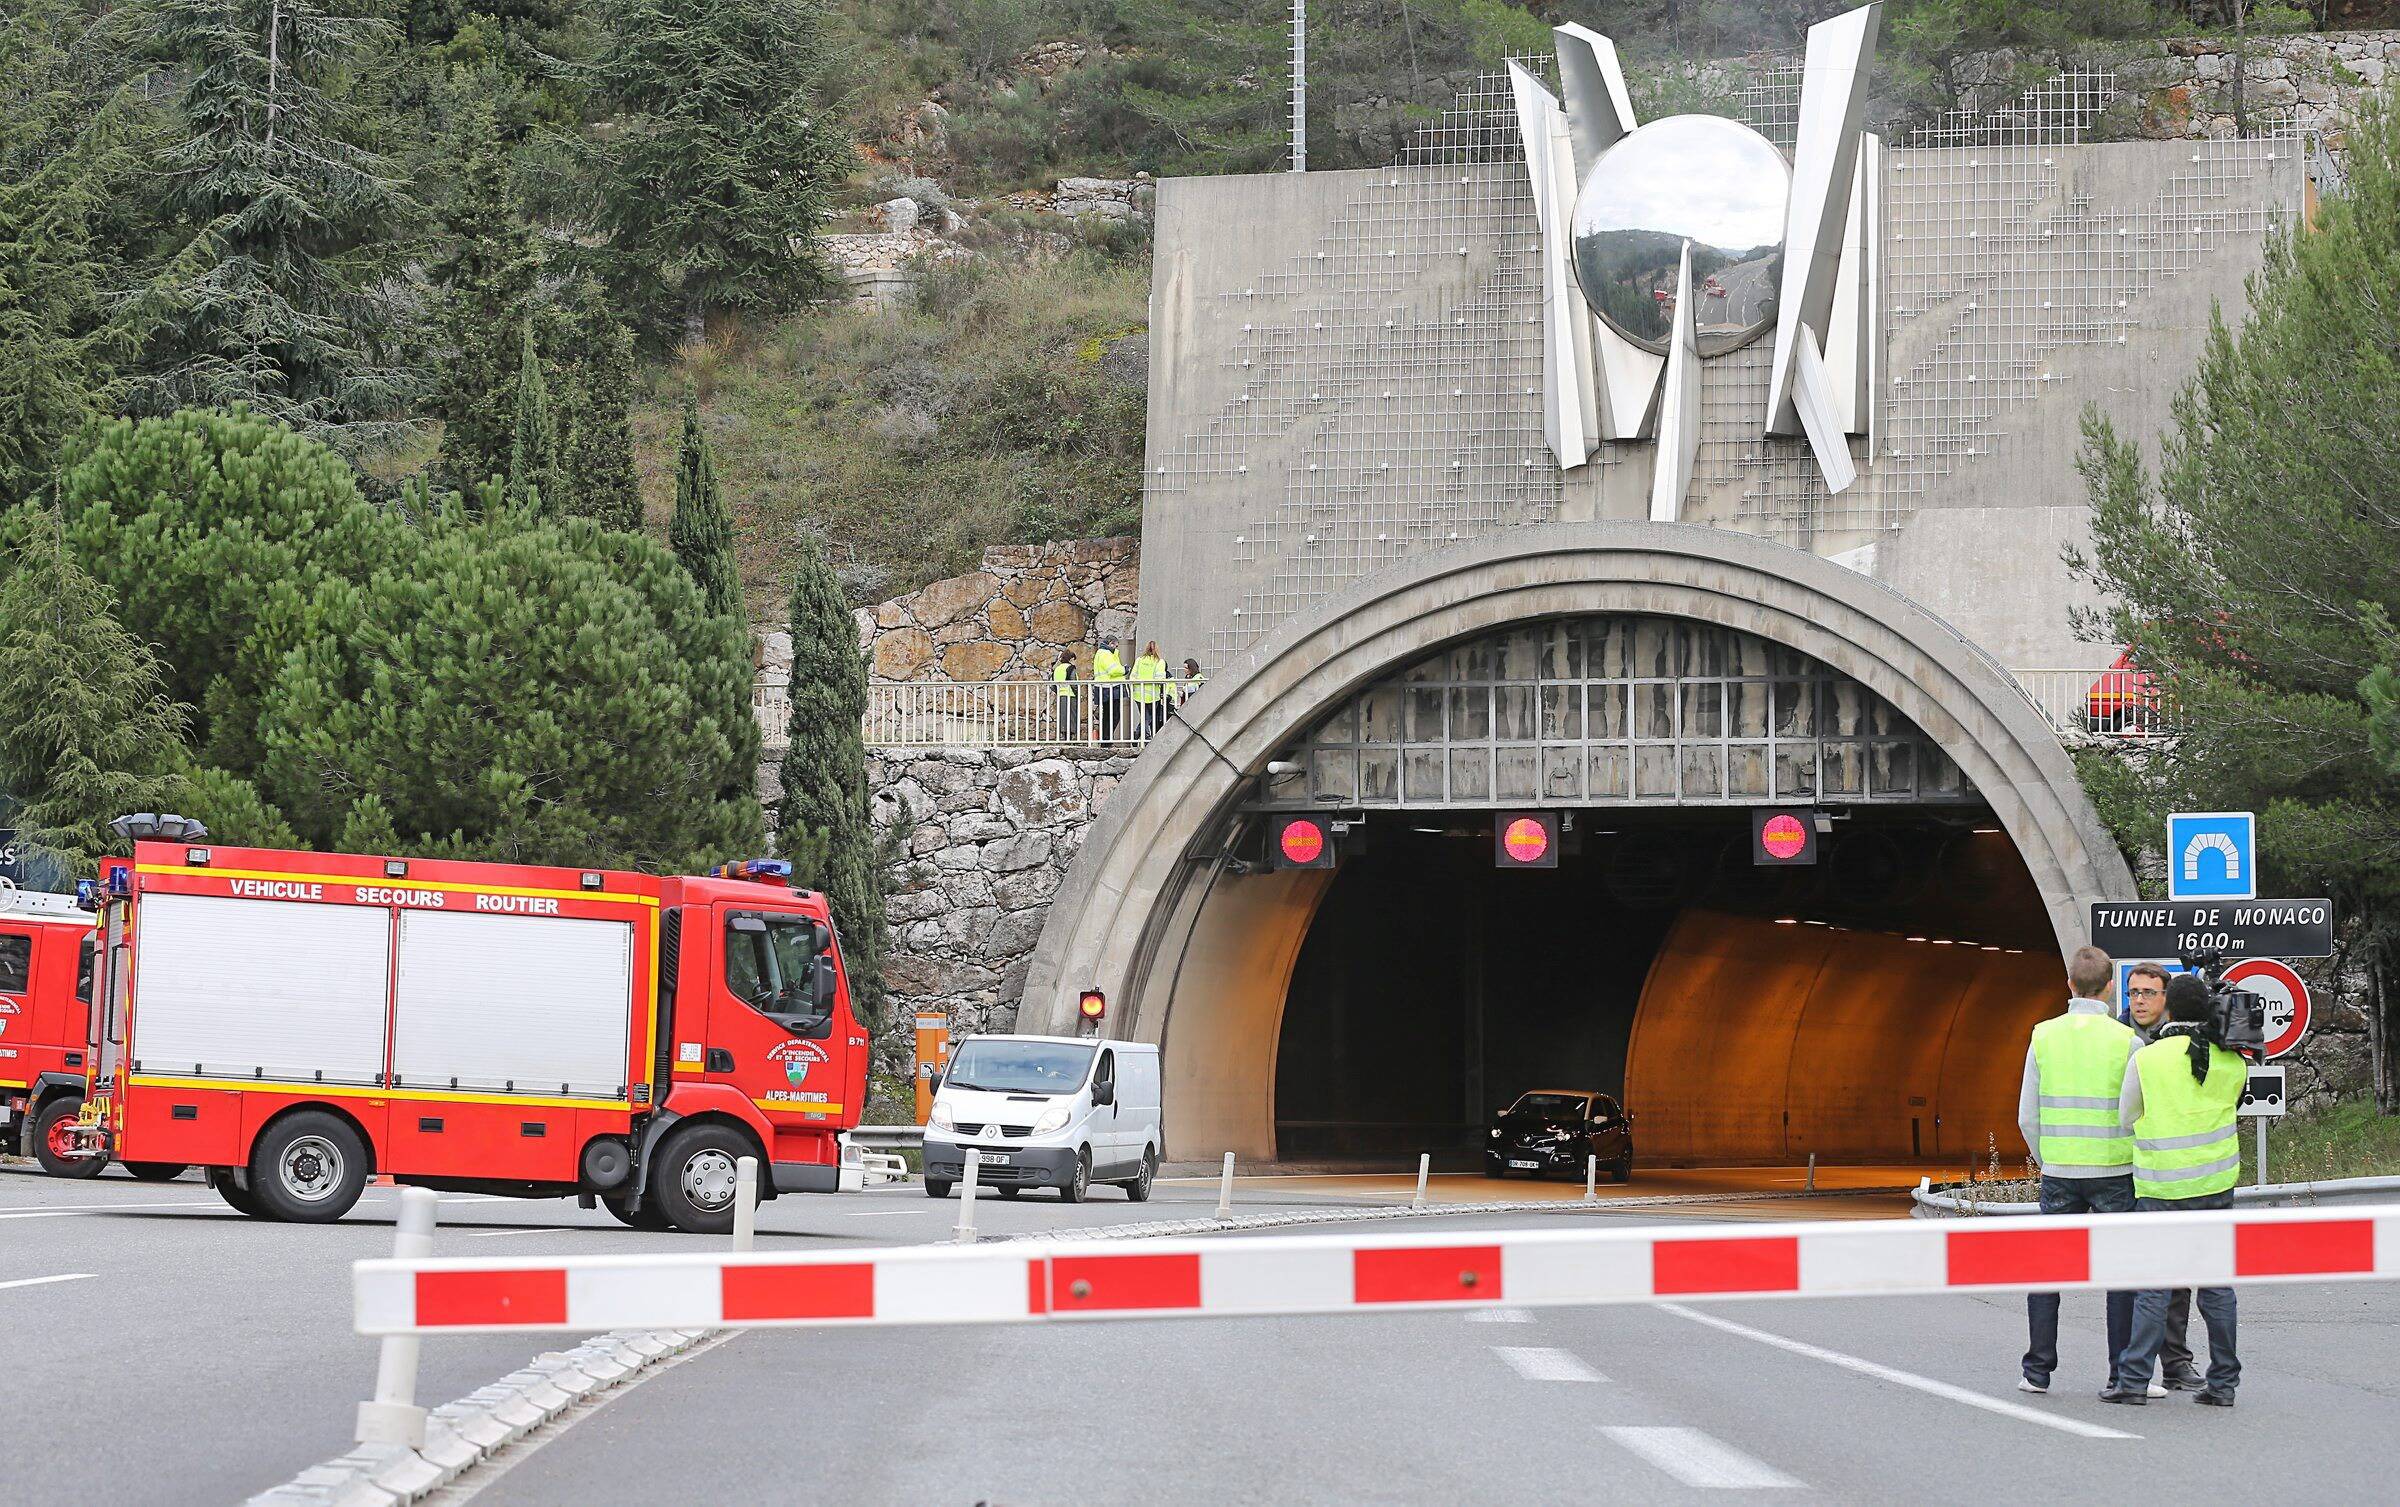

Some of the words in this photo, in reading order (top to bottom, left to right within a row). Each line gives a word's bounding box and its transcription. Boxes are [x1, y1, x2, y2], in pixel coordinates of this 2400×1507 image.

[229, 878, 323, 900] VEHICULE
[355, 887, 445, 907] SECOURS
[475, 894, 560, 914] ROUTIER
[2097, 909, 2178, 928] TUNNEL
[2193, 908, 2221, 927] DE
[2233, 907, 2326, 926] MONACO
[2176, 932, 2230, 951] 1600
[2231, 938, 2245, 950] m
[766, 1042, 787, 1061] SERVICE
[765, 1090, 828, 1103] ALPES-MARITIMES
